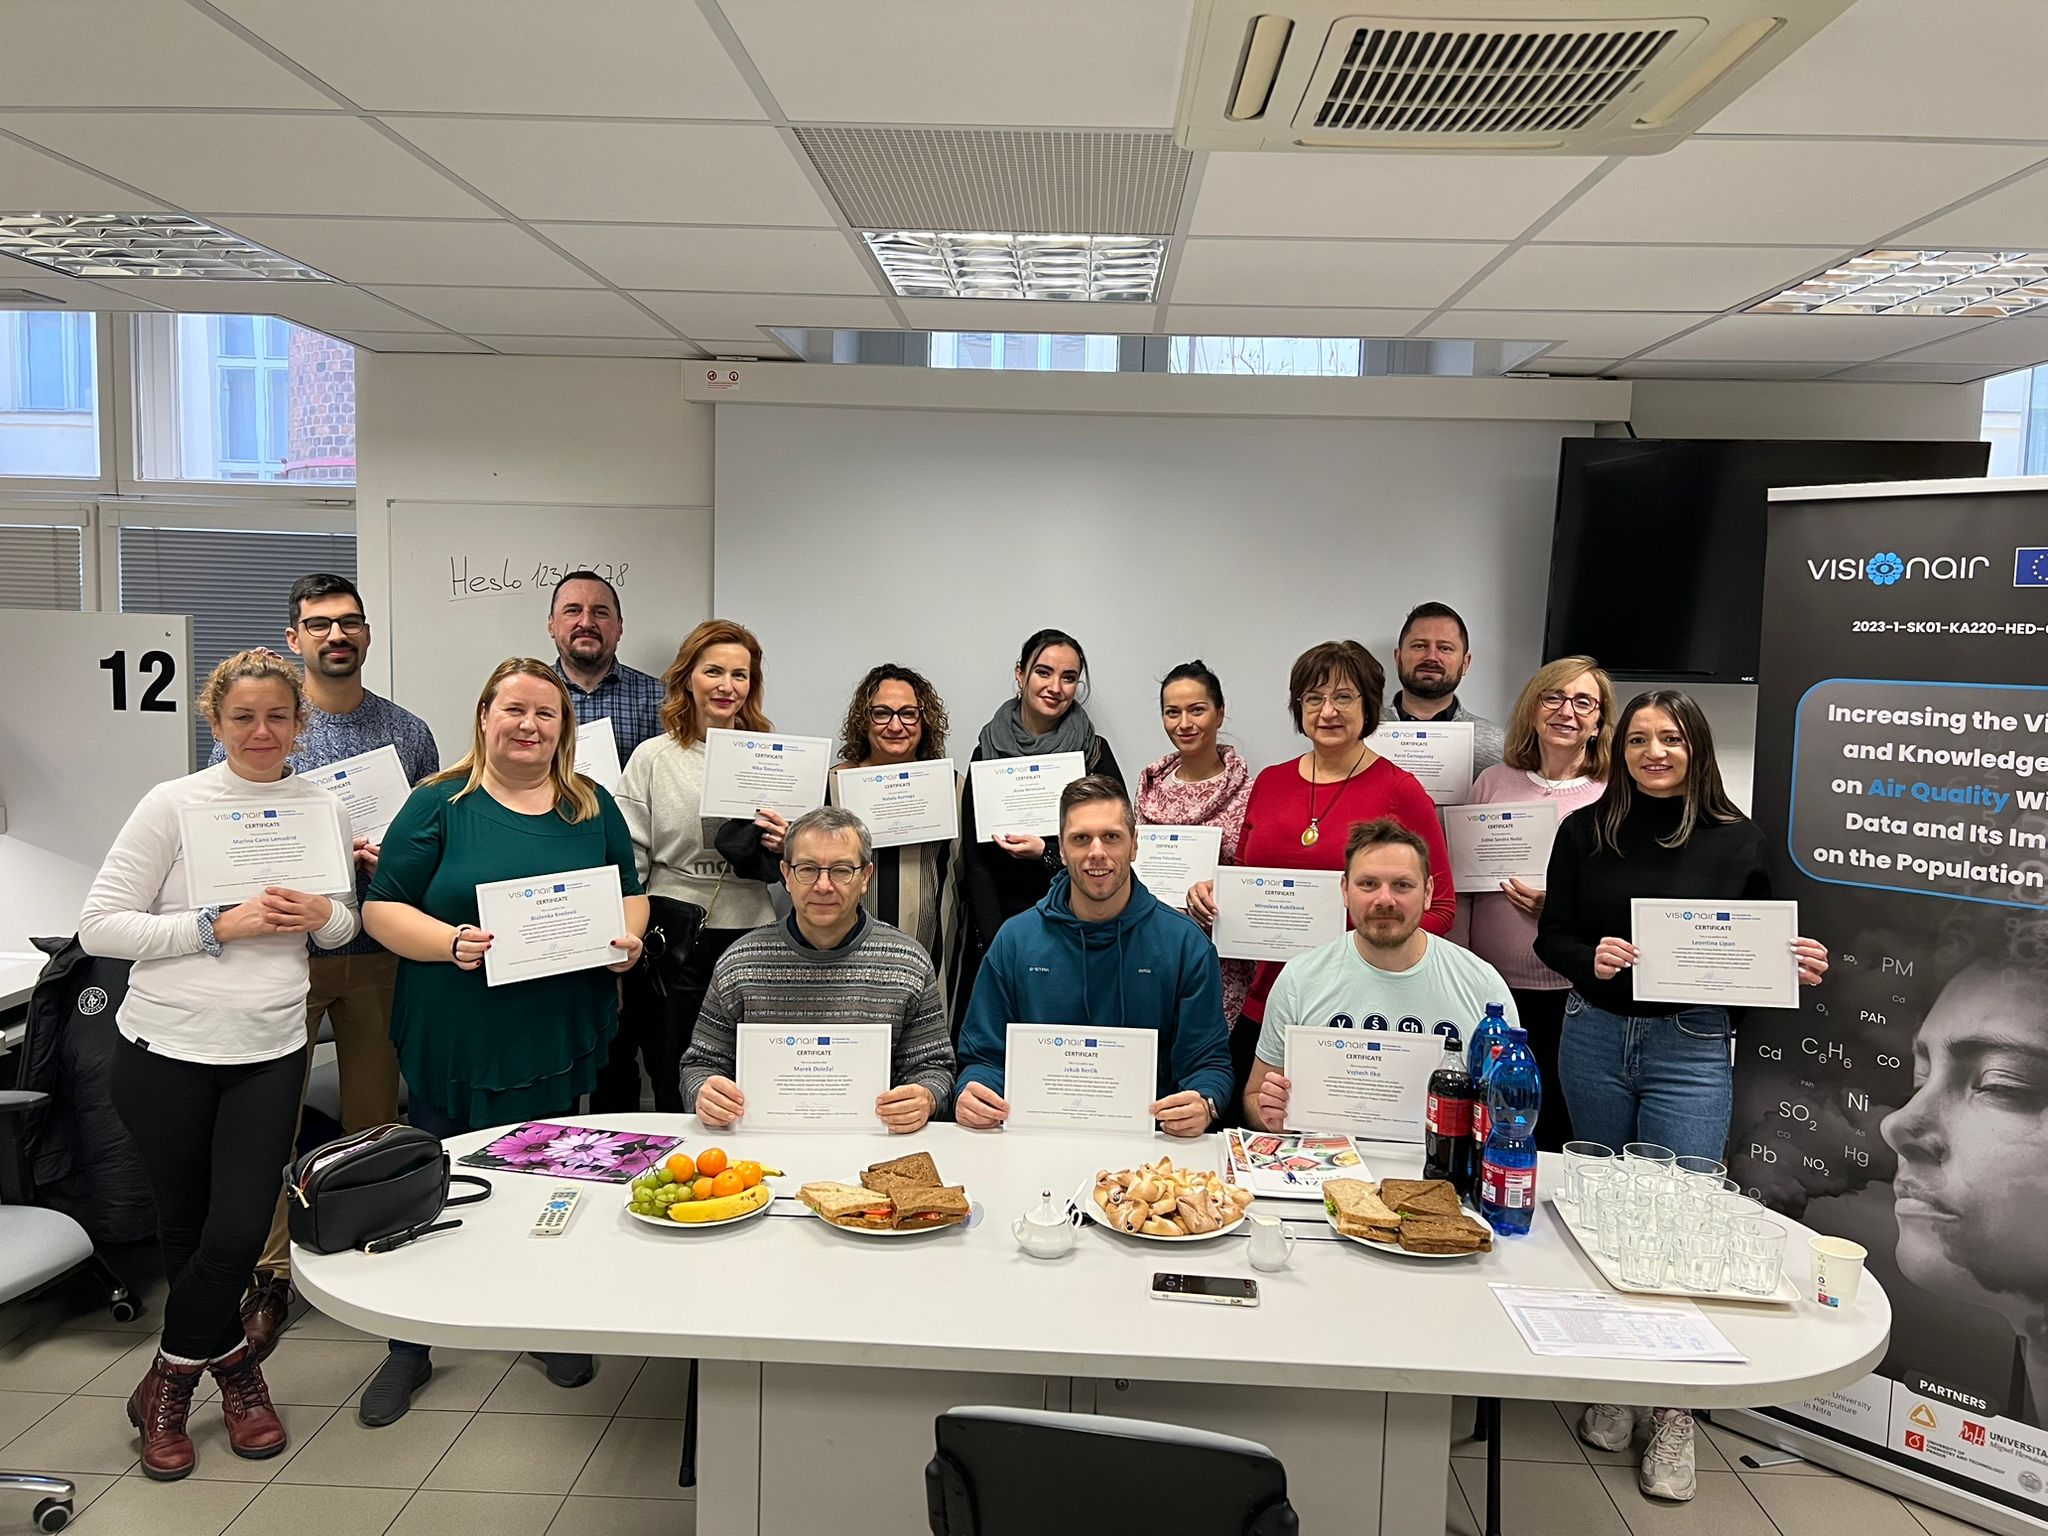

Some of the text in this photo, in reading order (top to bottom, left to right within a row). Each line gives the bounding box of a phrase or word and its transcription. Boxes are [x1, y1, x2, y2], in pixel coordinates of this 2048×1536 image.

[450, 556, 522, 595] Heslo
[100, 650, 177, 712] 12
[1828, 704, 1967, 734] Increasing
[1972, 711, 2018, 731] the
[1843, 743, 2048, 777] and Knowledge
[1831, 779, 1862, 795] on
[1867, 778, 1906, 798] Air
[1911, 782, 2010, 813] Quality
[1845, 813, 1907, 834] Data
[1913, 822, 1964, 841] and
[1969, 824, 2003, 845] Its
[1813, 847, 2044, 887] on the Population
[535, 896, 568, 906] CERTIFICATE
[1882, 957, 1914, 977] PM
[1337, 1018, 1346, 1028] V
[1371, 1016, 1380, 1030] Š
[1402, 1021, 1419, 1033] Ch
[1860, 1010, 1886, 1025] PAh
[1758, 1045, 1782, 1061] Cd
[1877, 1054, 1901, 1069] CO
[1848, 1091, 1869, 1112] Ni
[1750, 1143, 1777, 1164] Pb
[1844, 1145, 1869, 1168] Hg
[1832, 1391, 1872, 1412] University
[1919, 1378, 1988, 1411] PARTNERS
[1803, 1400, 1832, 1417] in Nitra
